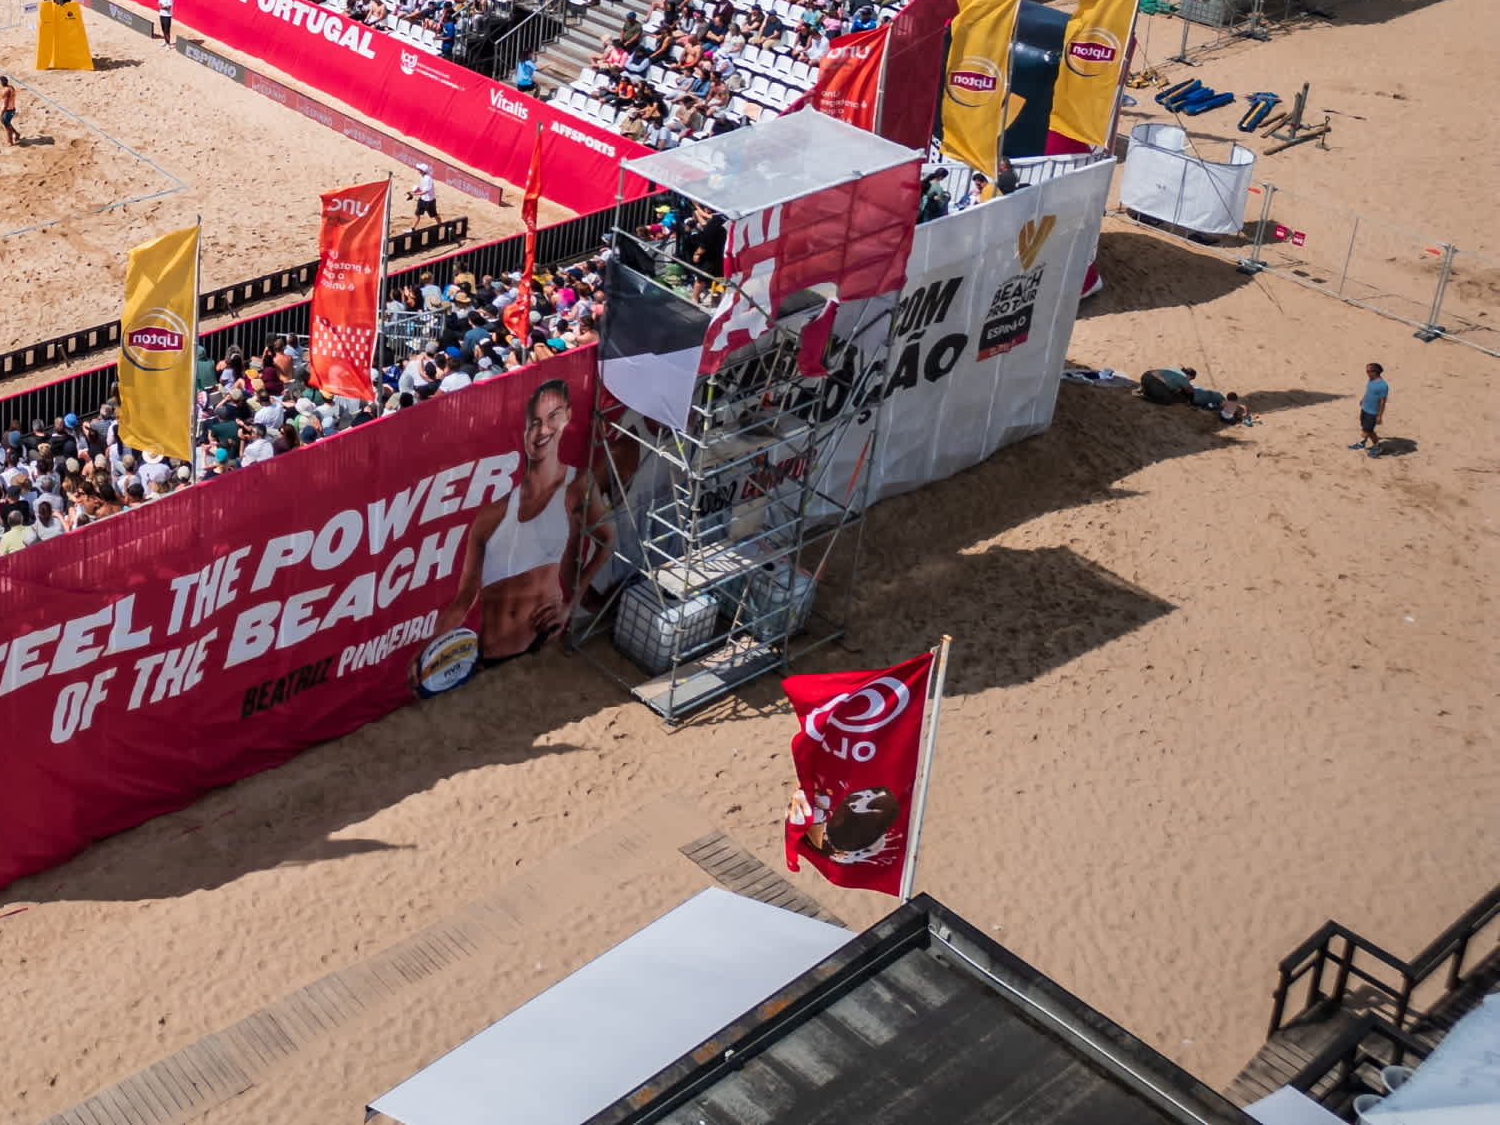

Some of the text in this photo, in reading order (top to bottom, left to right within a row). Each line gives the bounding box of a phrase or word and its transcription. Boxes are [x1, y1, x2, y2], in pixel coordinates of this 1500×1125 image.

[185, 43, 237, 78] ESPINHO
[489, 87, 530, 120] Vitalis
[550, 121, 616, 158] AFFSPORTS
[165, 545, 252, 636] THE
[250, 451, 521, 593] POWER
[50, 523, 468, 745] OF THE BEACH
[240, 609, 439, 719] BEATRIZ PINHEIRO
